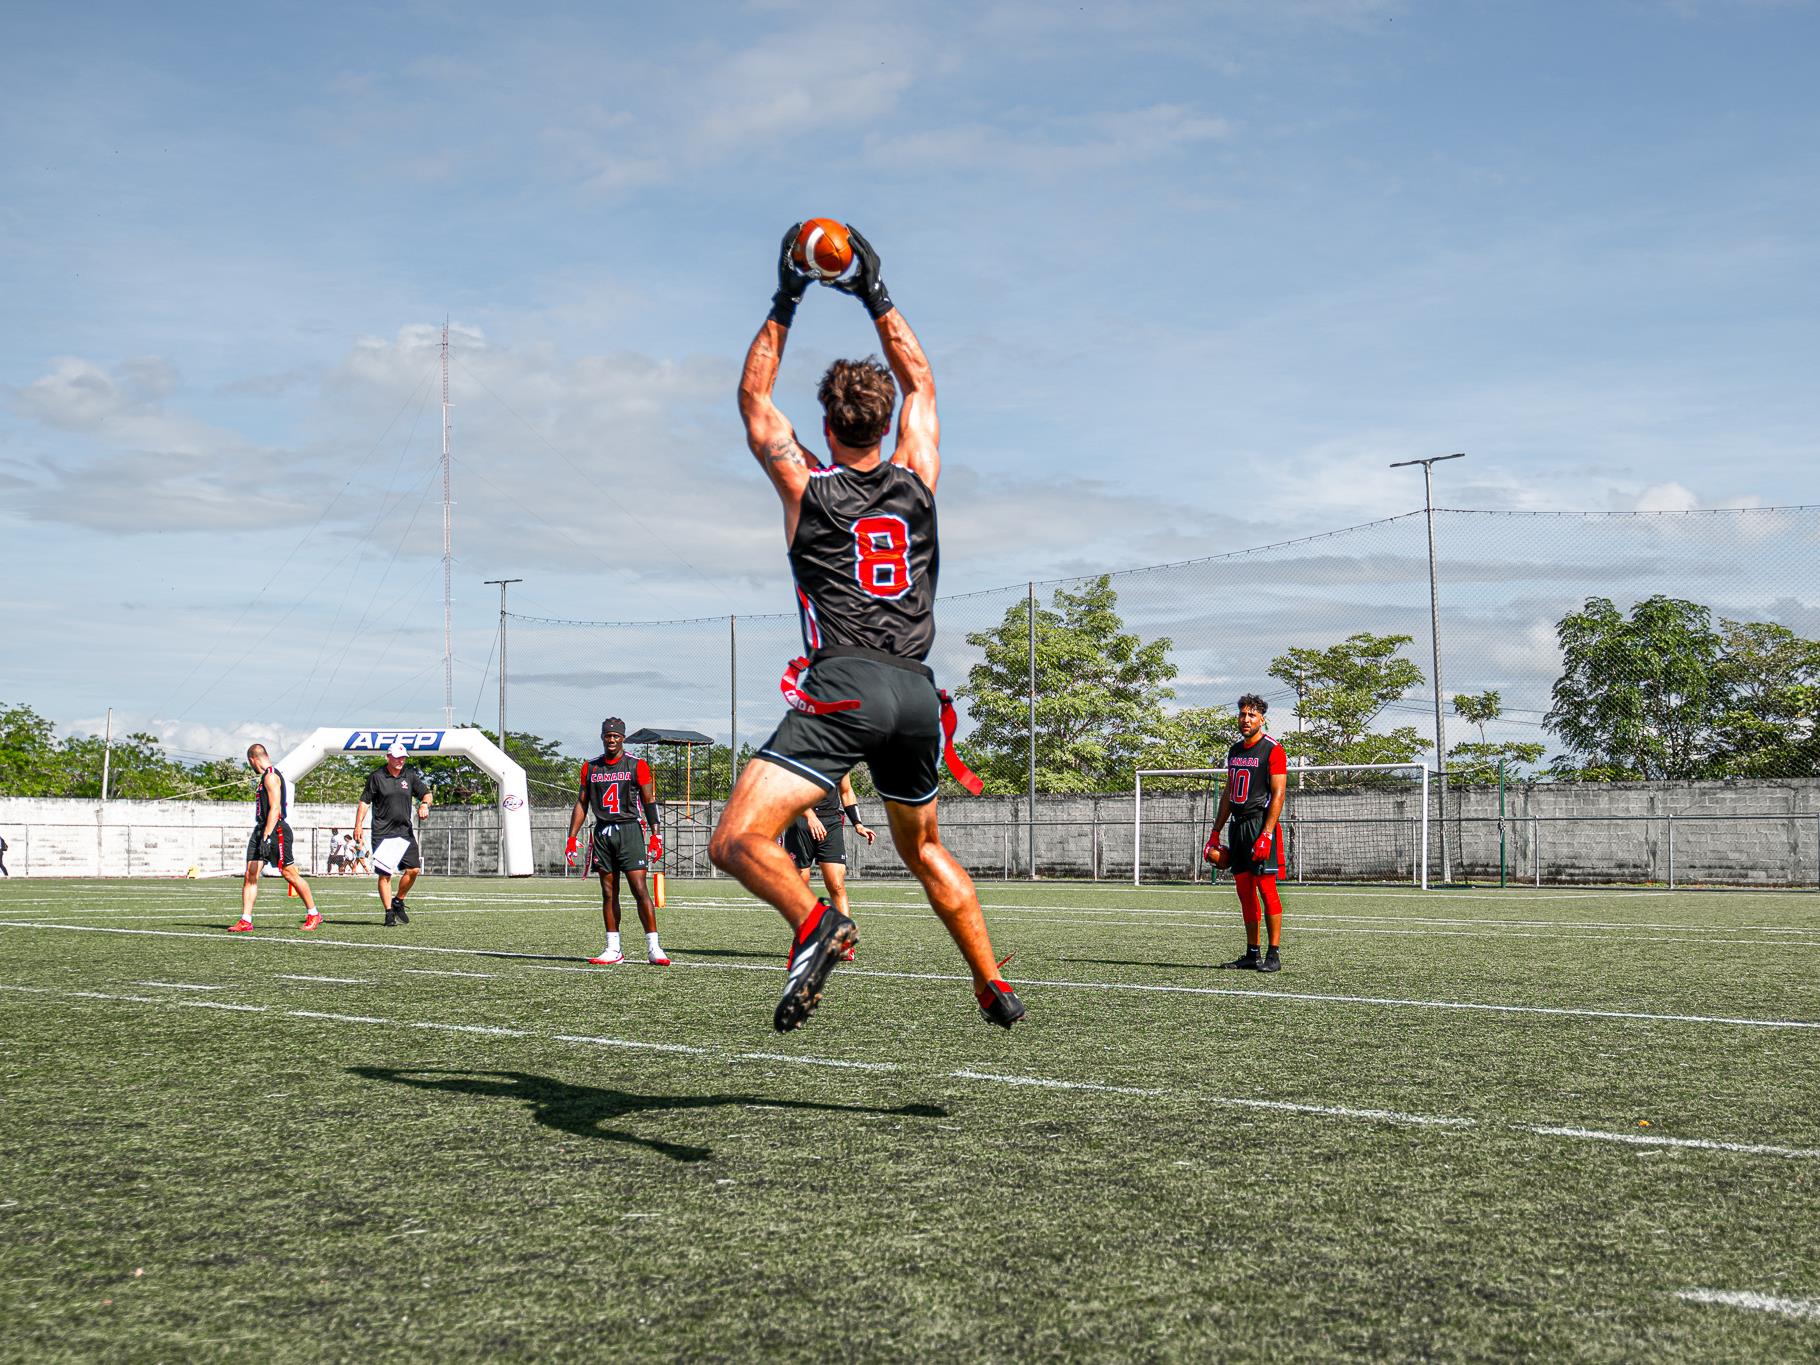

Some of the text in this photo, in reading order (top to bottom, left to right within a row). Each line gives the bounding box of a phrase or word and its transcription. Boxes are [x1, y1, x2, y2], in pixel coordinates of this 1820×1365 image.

[851, 514, 912, 600] 8
[349, 732, 438, 749] AFFP
[591, 772, 632, 783] CANADA
[1230, 768, 1250, 804] 10
[602, 782, 620, 814] 4
